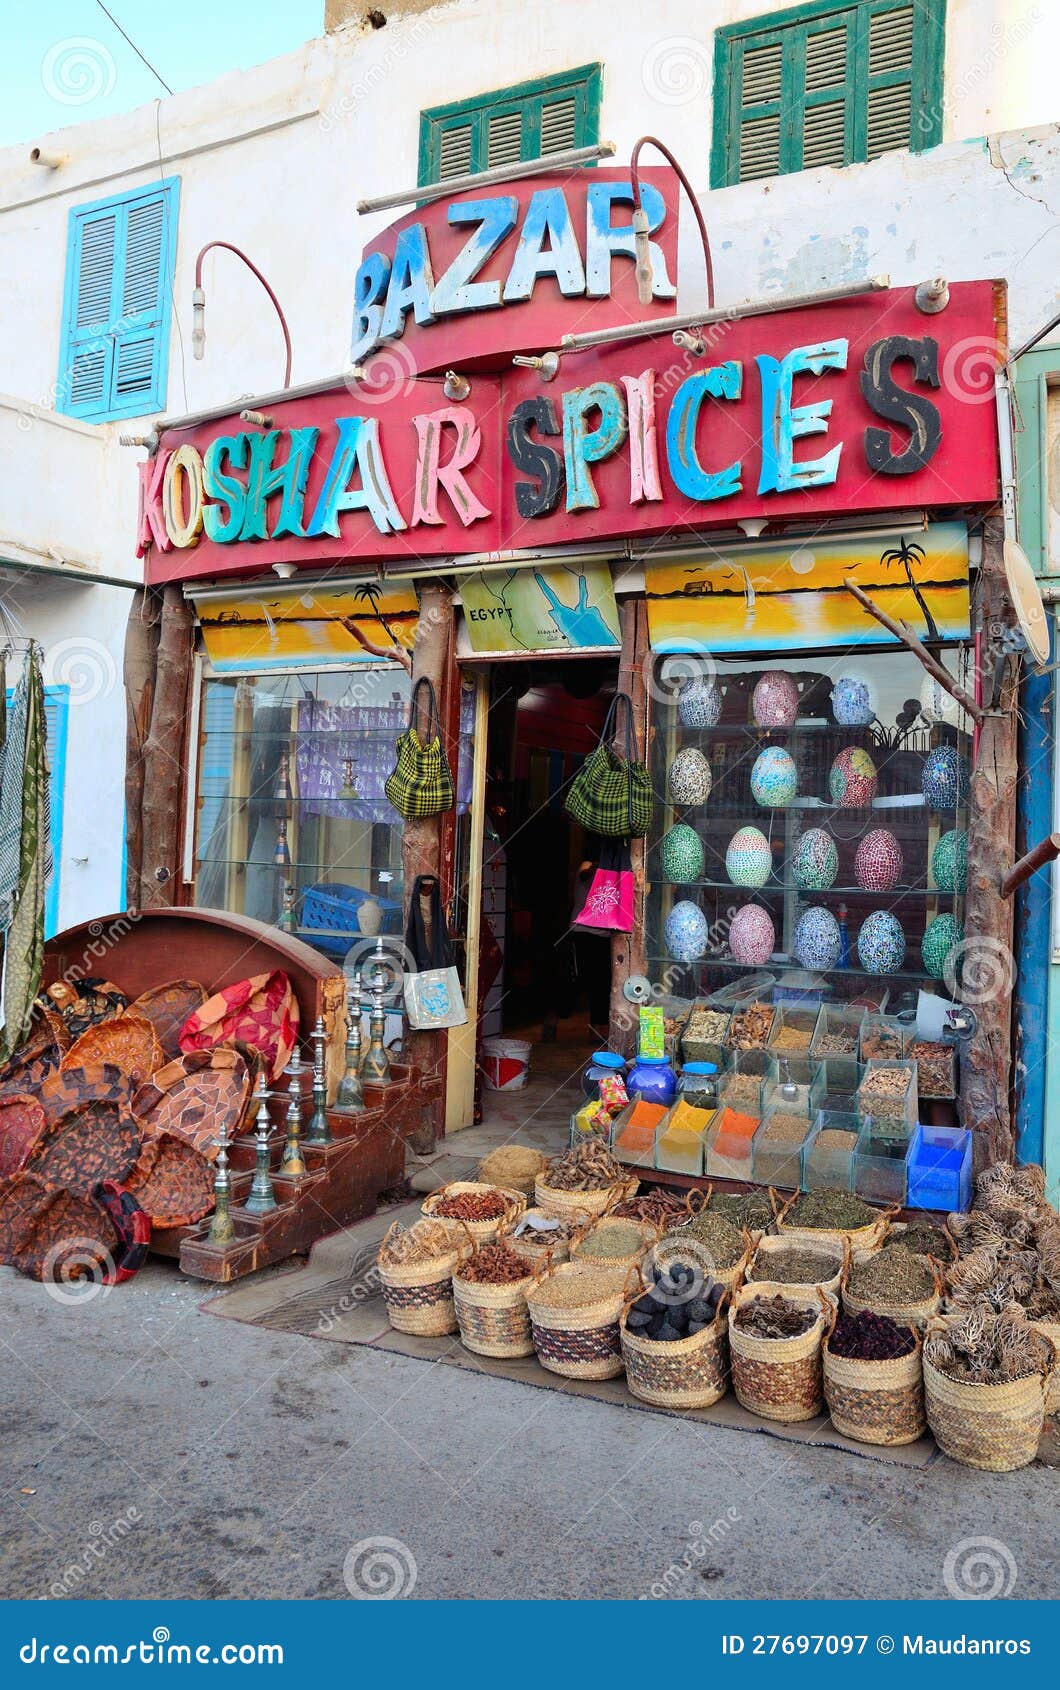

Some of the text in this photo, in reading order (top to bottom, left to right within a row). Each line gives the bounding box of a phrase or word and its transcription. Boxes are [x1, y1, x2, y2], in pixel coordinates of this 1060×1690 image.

[351, 181, 678, 366] BAZAR
[136, 335, 943, 559] KOSHAR SPICES
[470, 607, 513, 621] EGYPT
